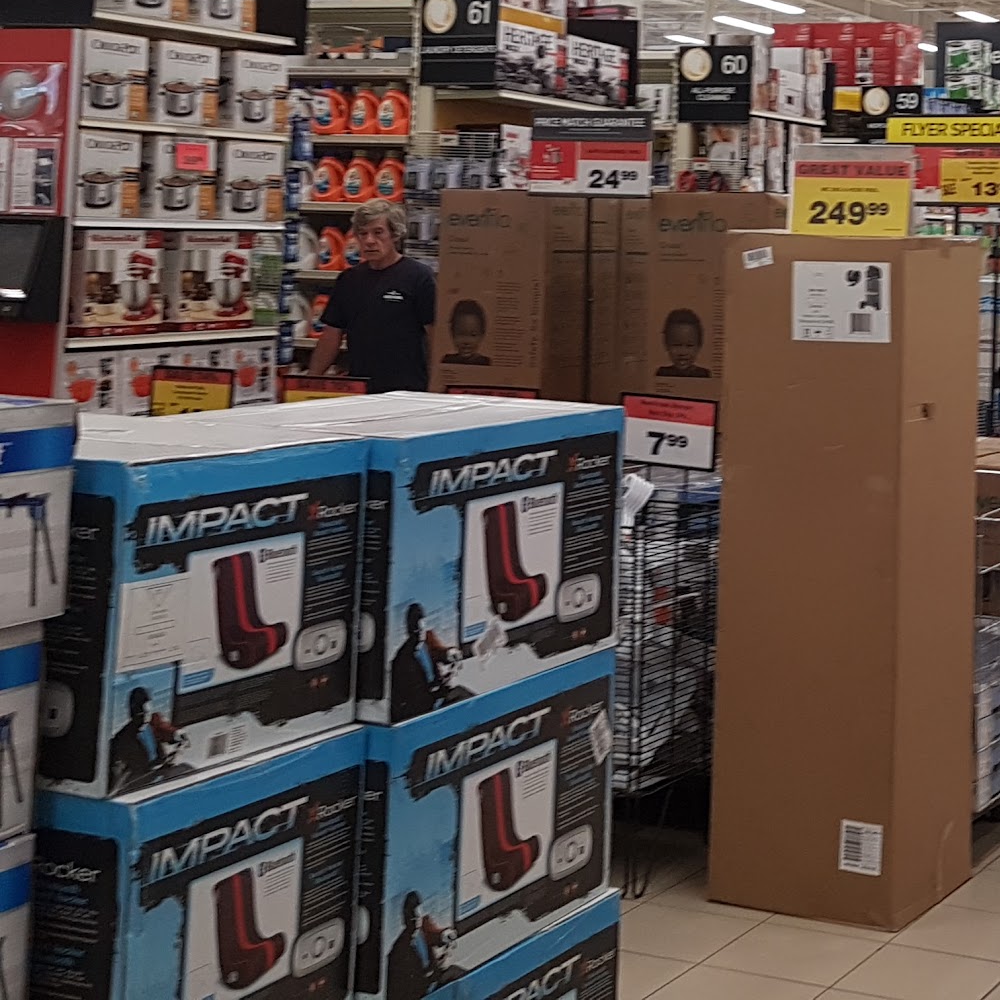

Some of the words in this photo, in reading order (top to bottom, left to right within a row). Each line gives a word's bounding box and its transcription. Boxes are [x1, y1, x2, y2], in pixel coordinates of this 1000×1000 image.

[467, 0, 491, 25] 61
[721, 54, 748, 75] 60
[896, 92, 920, 109] 59
[900, 122, 948, 137] FLYER
[798, 164, 849, 175] GREAT
[854, 165, 906, 177] VALUE
[427, 450, 558, 497] IMPACT
[146, 493, 309, 546] IMPACT
[425, 707, 552, 782] IMPACT
[149, 795, 310, 881] IMPACT
